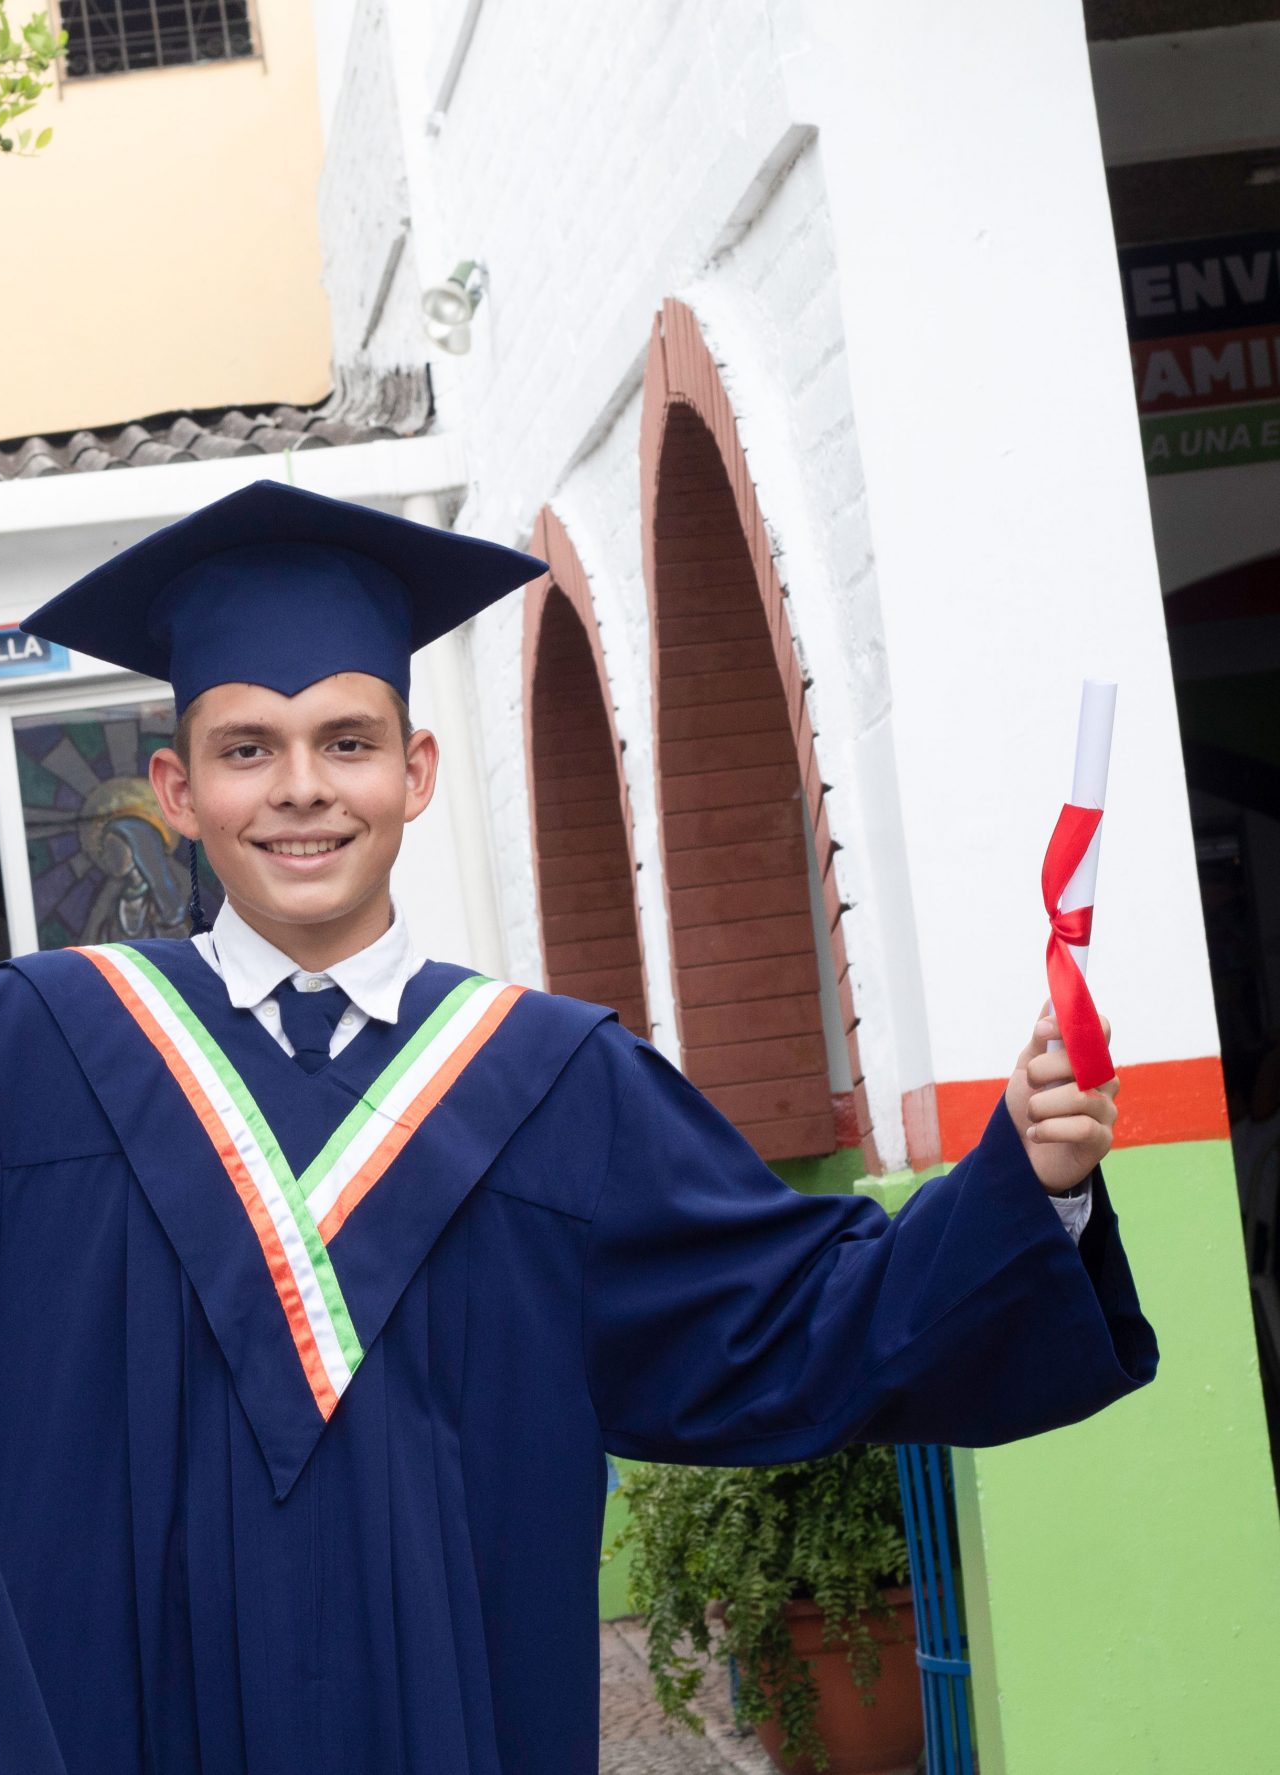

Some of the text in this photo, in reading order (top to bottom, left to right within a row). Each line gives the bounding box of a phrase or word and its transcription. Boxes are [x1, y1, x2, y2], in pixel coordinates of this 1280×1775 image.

[1130, 250, 1280, 317] ENV
[1132, 337, 1280, 402] AMI
[1180, 423, 1251, 456] UNA
